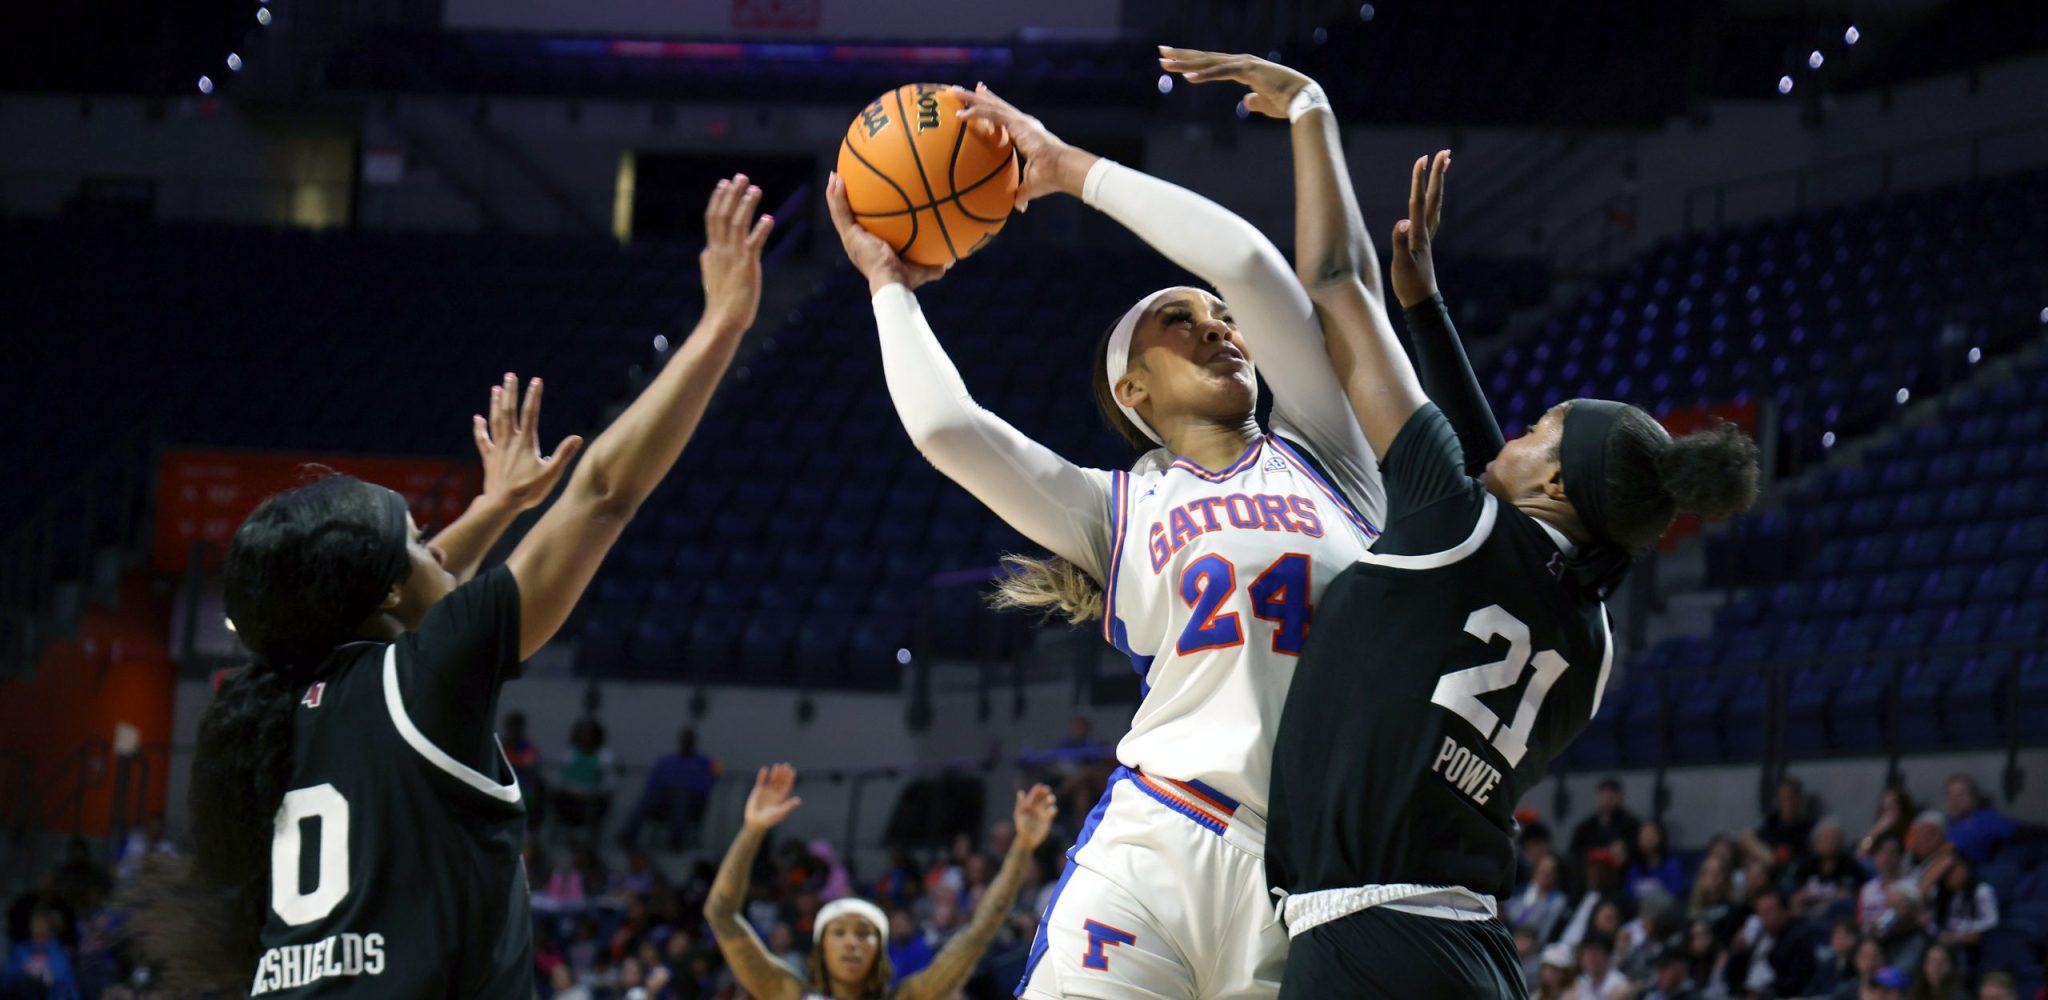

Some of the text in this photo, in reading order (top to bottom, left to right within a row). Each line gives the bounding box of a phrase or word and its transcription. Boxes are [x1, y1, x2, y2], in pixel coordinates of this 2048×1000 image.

[1149, 493, 1325, 575] GATORS
[1176, 552, 1314, 657] 24
[1430, 603, 1571, 770] 21
[1431, 735, 1503, 807] POWE
[271, 782, 350, 927] 0
